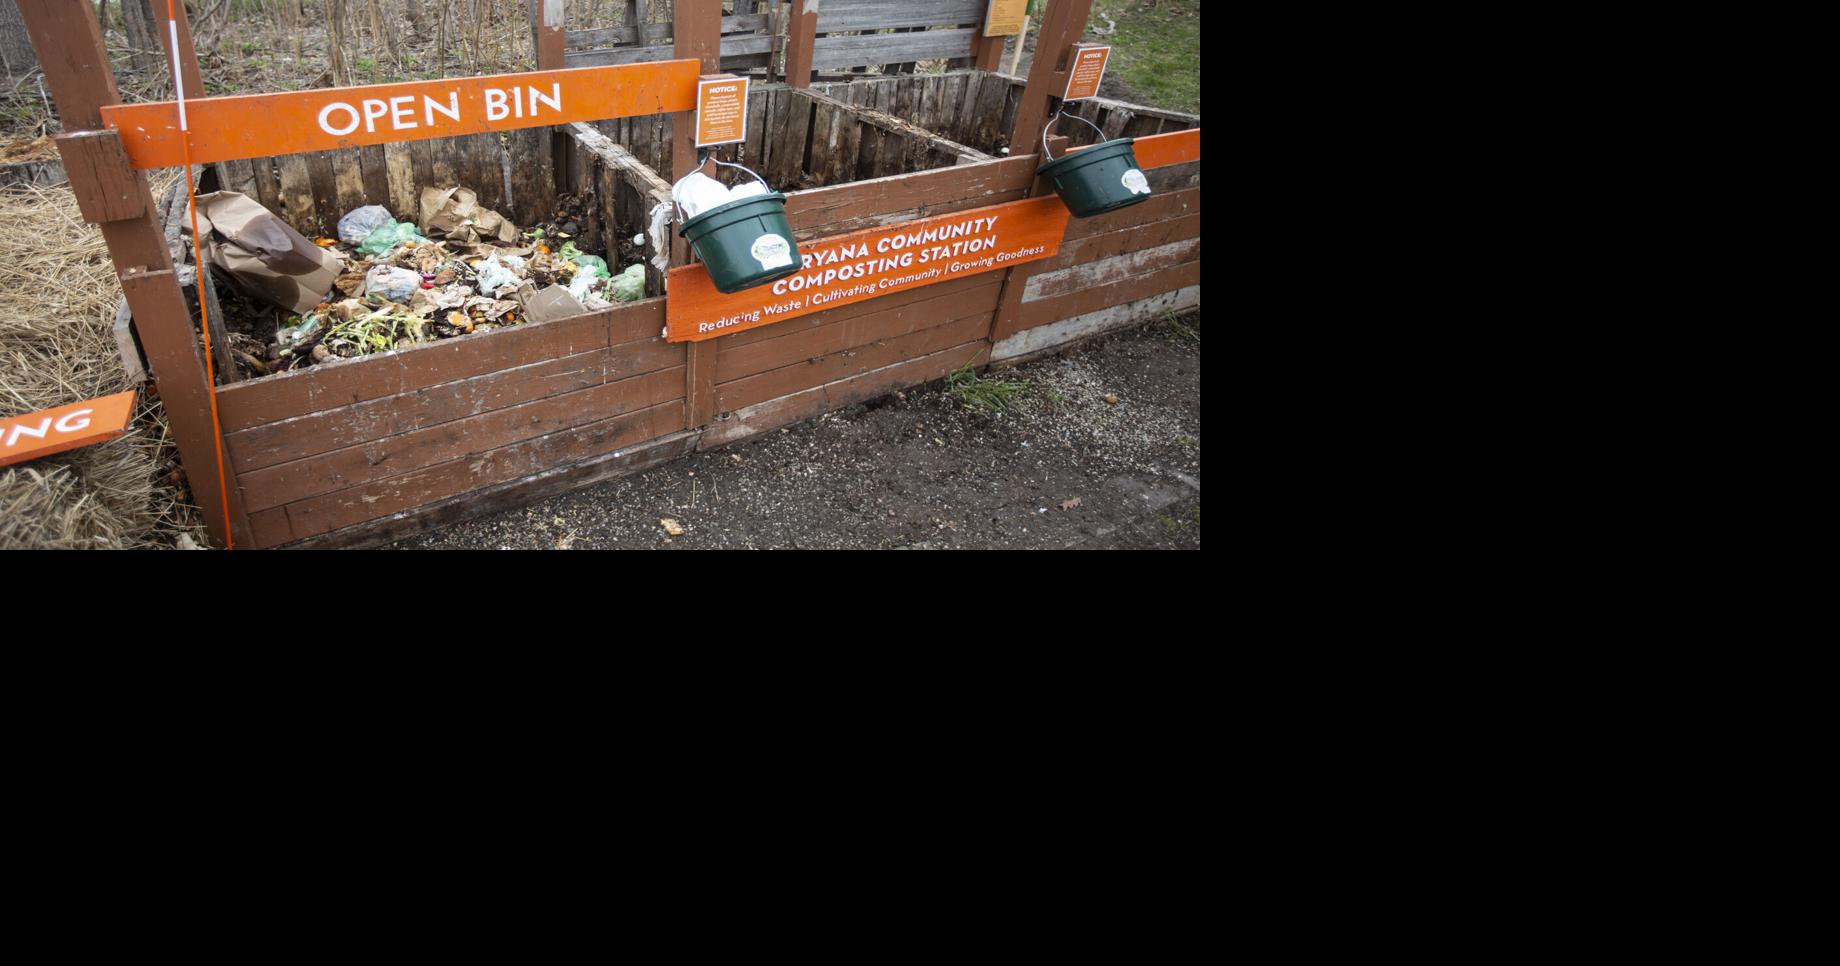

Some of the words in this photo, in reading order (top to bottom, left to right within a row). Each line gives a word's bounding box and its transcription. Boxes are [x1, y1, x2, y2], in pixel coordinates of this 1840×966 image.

[318, 92, 461, 136] OPEN
[484, 83, 562, 121] BIN
[772, 252, 913, 295] COMPOSTING
[918, 235, 997, 263] STATION
[801, 242, 869, 270] RYANA
[877, 215, 998, 254] COMMUNITY
[699, 311, 760, 333] Reducing
[763, 301, 801, 316] Waste
[812, 282, 876, 305] Cultivating
[879, 268, 942, 289] Community
[951, 256, 994, 273] Growing
[996, 245, 1045, 263] Goodness
[0, 408, 94, 447] NG
